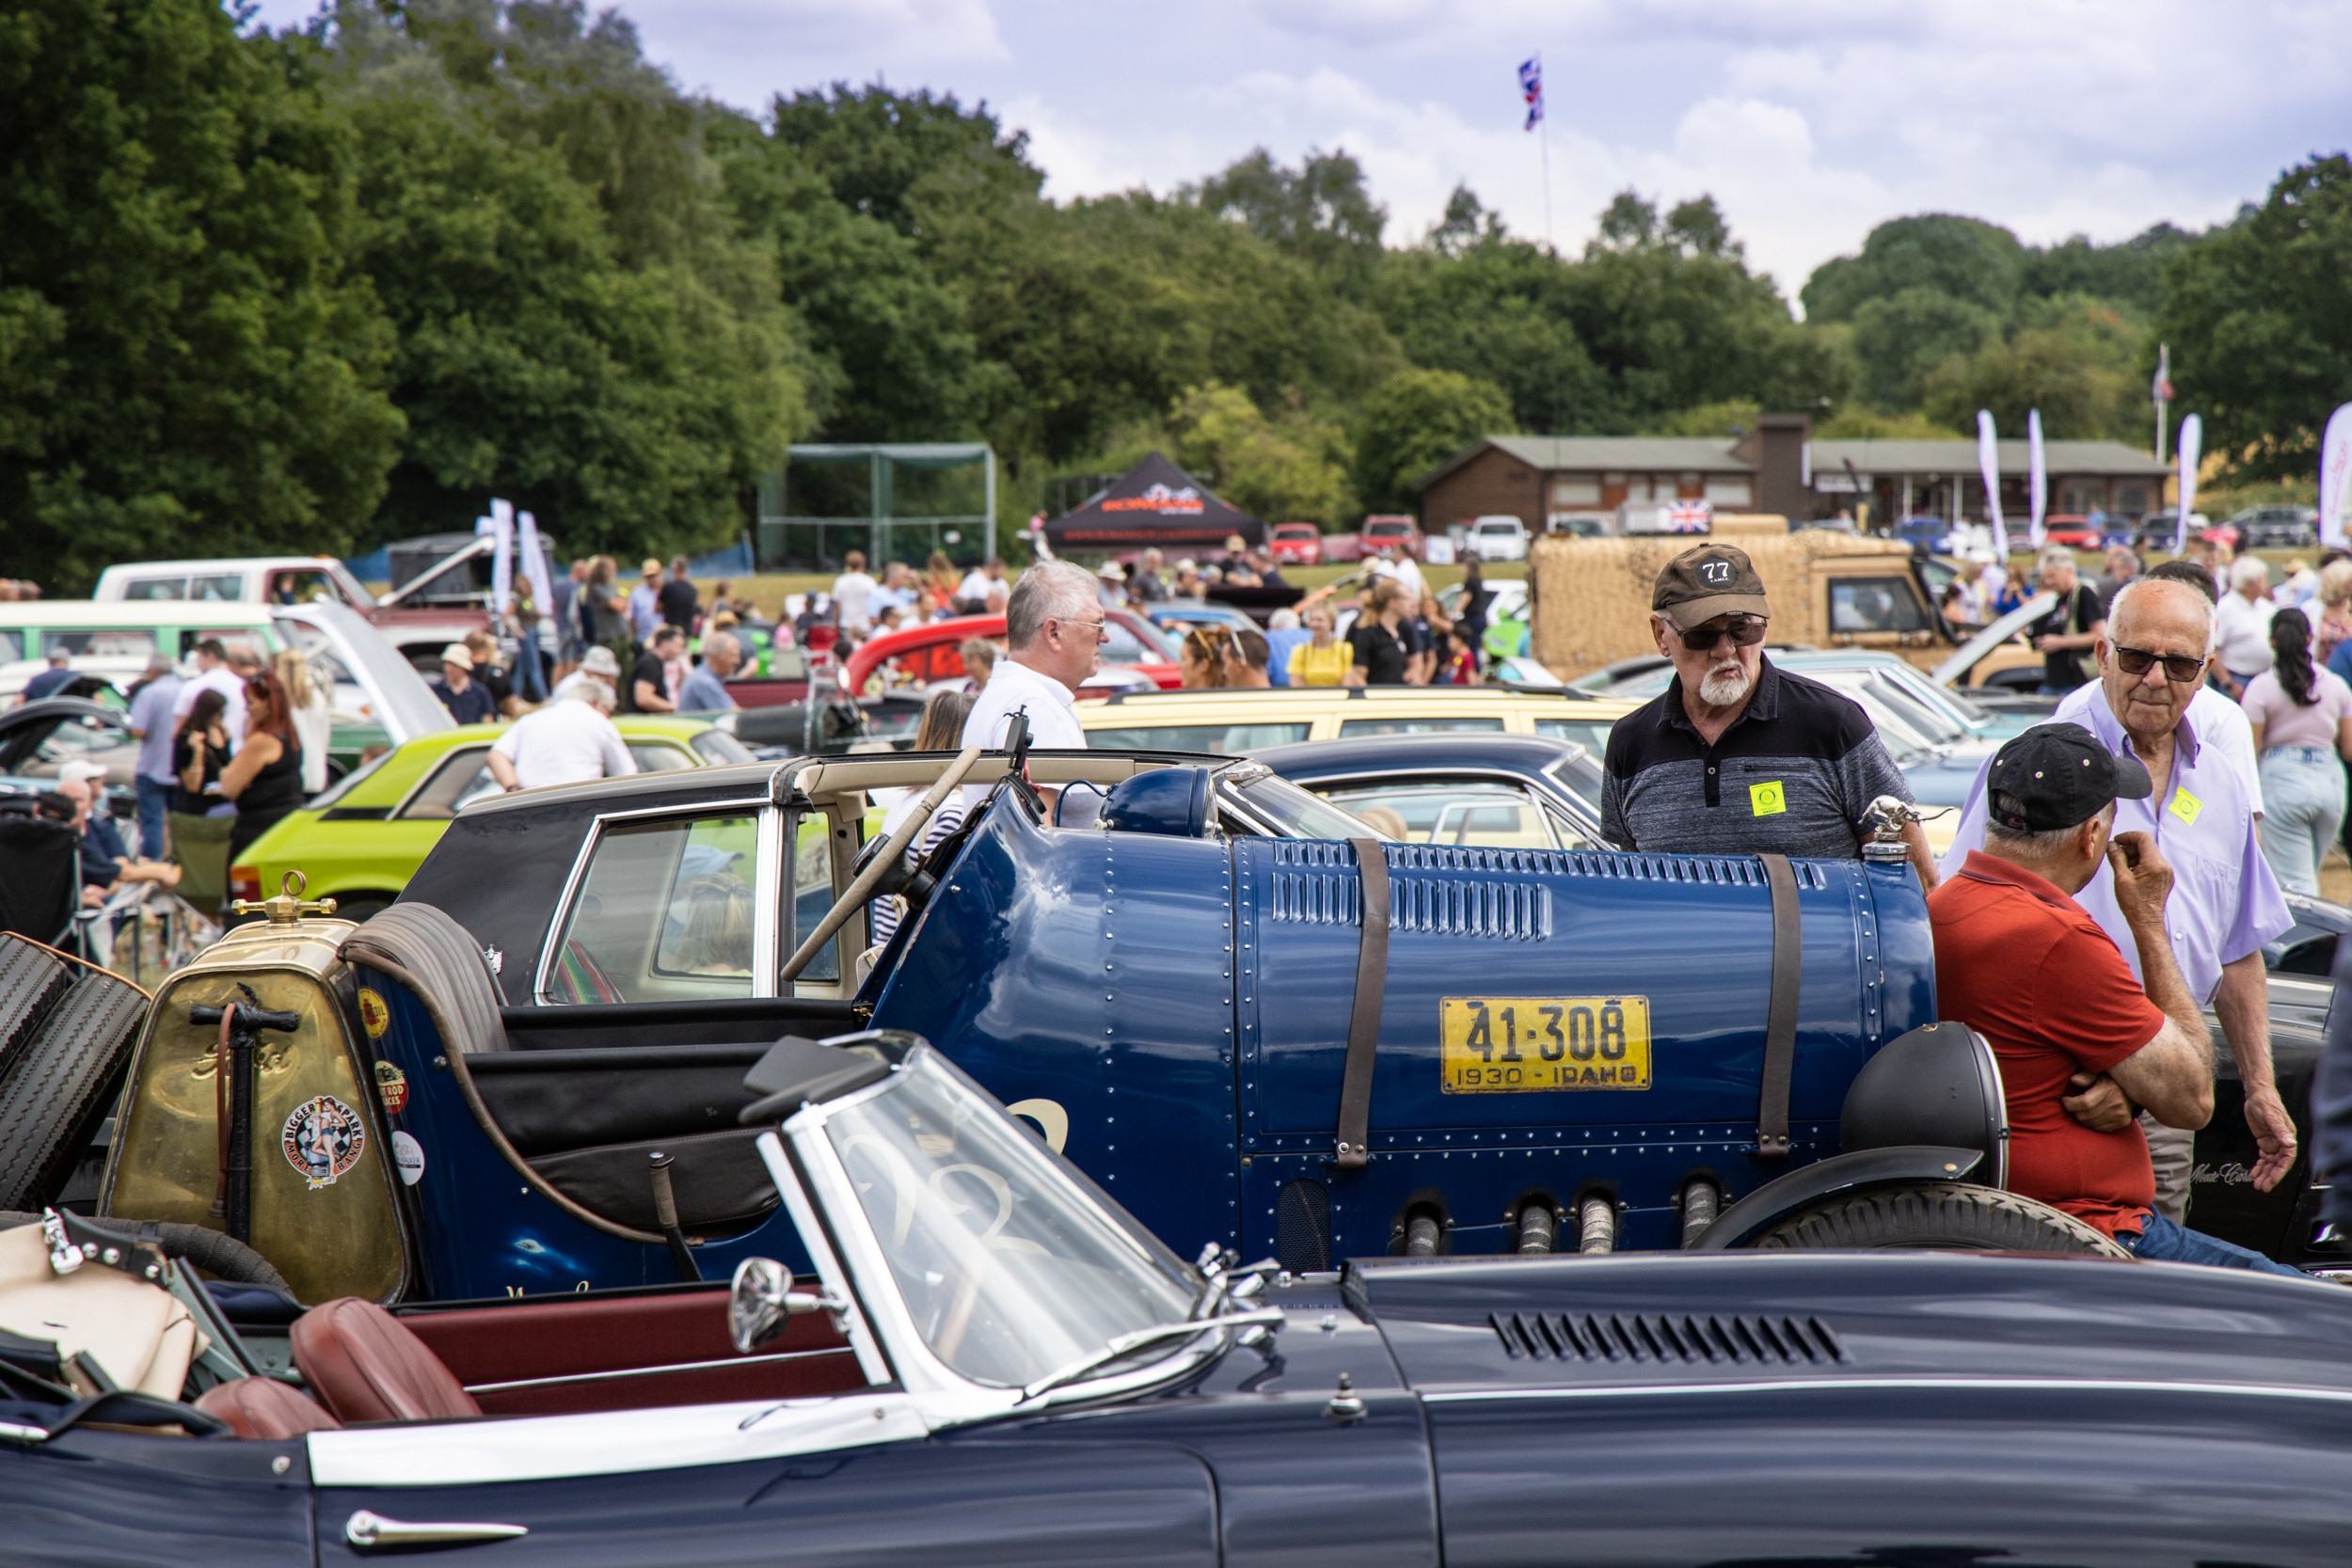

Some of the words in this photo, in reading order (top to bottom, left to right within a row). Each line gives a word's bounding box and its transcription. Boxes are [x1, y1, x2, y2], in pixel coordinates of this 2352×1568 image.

[1702, 562, 1729, 579] 77
[1457, 1067, 1523, 1085] 1930
[1553, 1065, 1637, 1084] IDAHO
[387, 1085, 405, 1096] ROD
[382, 1095, 401, 1105] ACES
[285, 1103, 315, 1139] BIGGER
[337, 1104, 361, 1137] SPARK
[286, 1144, 310, 1172] MORE
[337, 1142, 361, 1170] BANG
